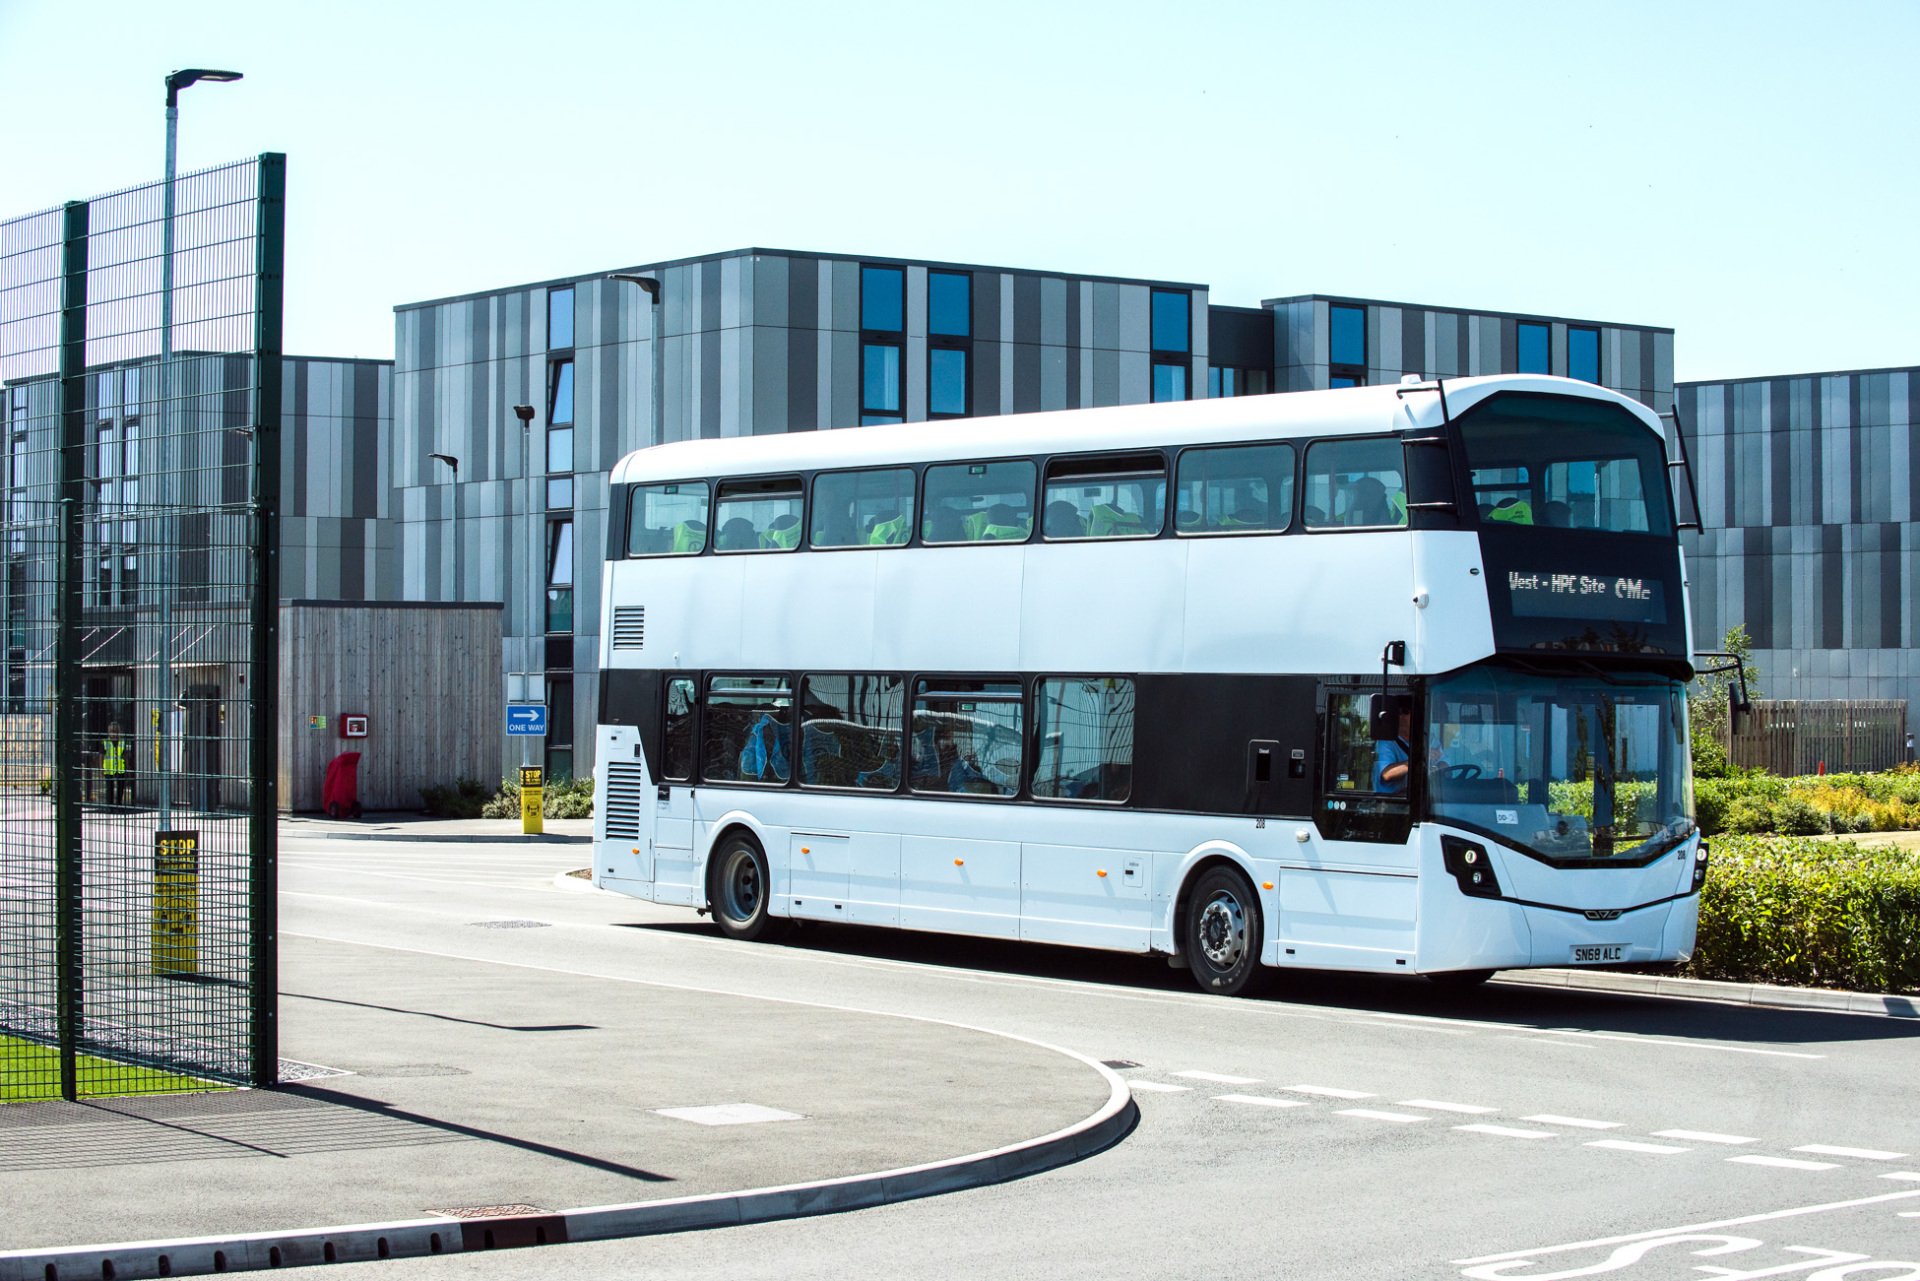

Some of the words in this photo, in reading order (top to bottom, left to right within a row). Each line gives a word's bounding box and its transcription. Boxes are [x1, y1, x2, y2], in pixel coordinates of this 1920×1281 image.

[1551, 574, 1576, 593] HPC
[1579, 576, 1605, 594] Site
[508, 724, 526, 732] ONE
[528, 724, 544, 732] WAY
[525, 769, 541, 779] STOP
[159, 838, 196, 856] STOP
[1575, 948, 1600, 961] SN68
[1603, 947, 1621, 960] ALC
